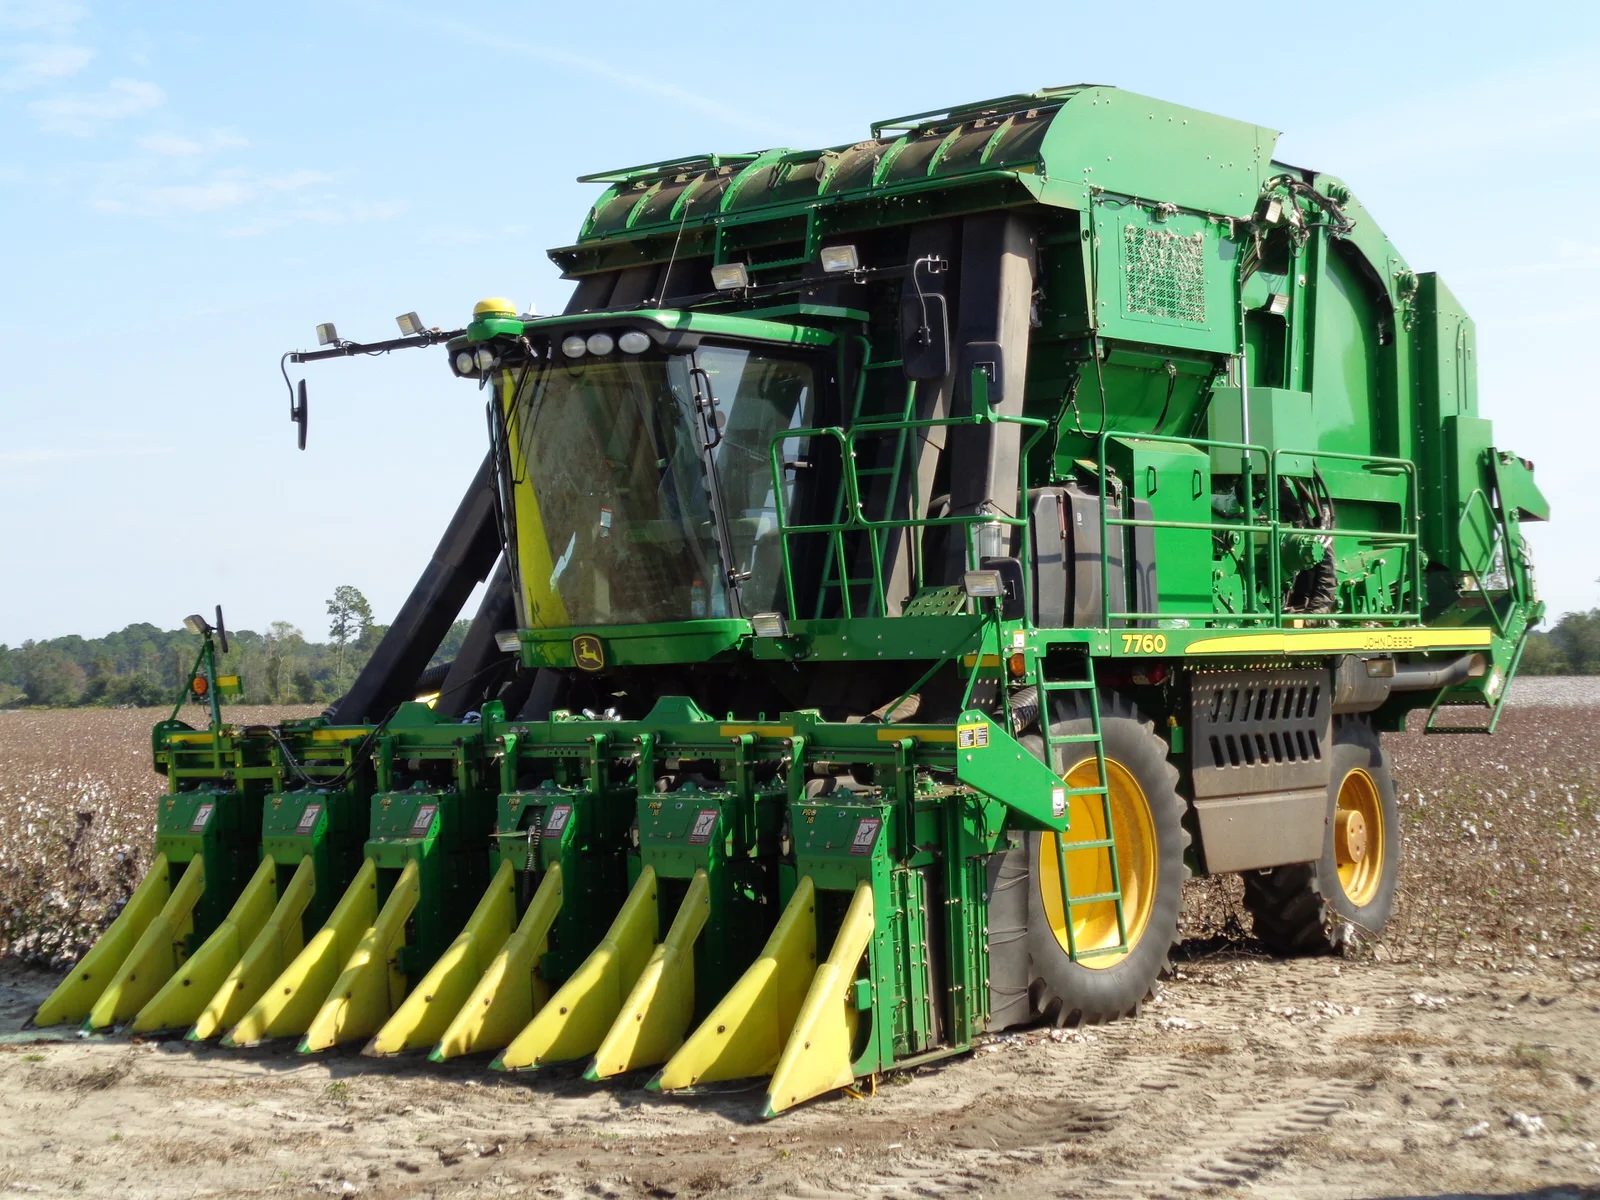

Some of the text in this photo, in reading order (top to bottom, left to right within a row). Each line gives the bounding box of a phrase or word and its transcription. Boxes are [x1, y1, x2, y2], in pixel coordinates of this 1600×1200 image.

[1121, 633, 1167, 654] 7760
[1363, 634, 1413, 648] JOHN DEERE
[802, 808, 817, 816] PRO
